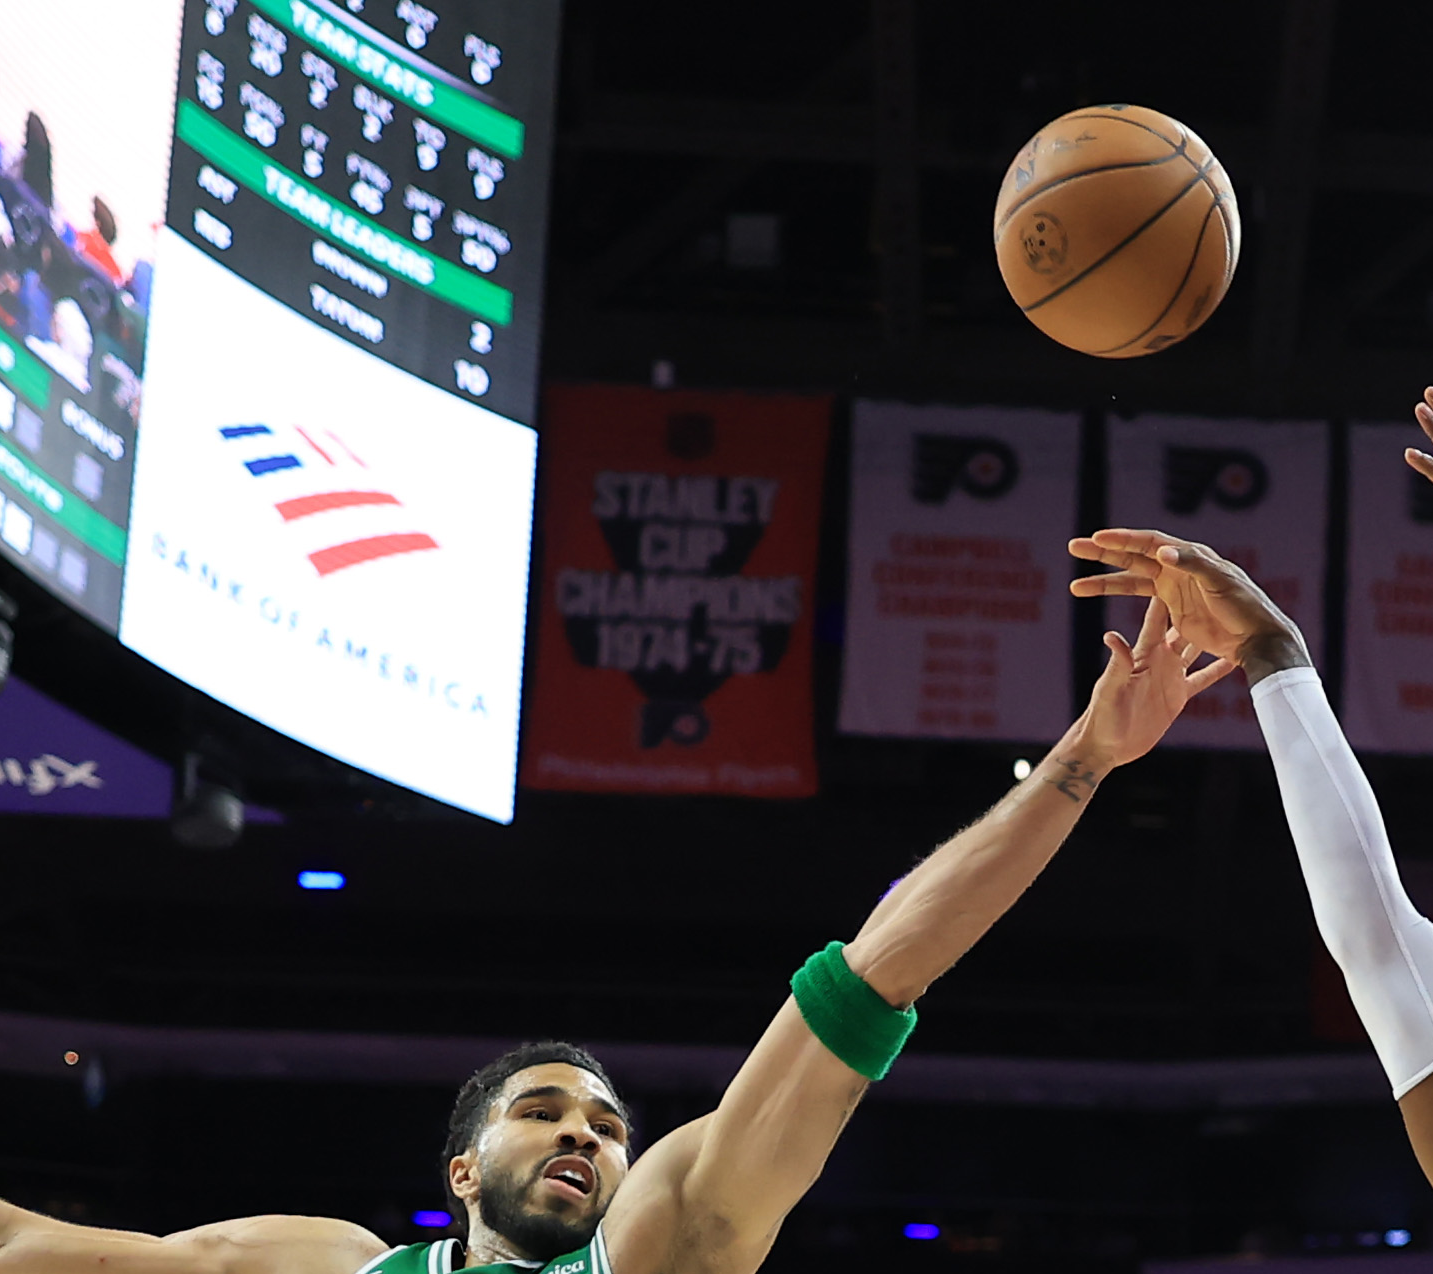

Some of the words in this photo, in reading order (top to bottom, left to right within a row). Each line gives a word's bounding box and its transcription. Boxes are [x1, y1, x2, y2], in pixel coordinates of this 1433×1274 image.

[592, 470, 780, 525] STANLEY
[639, 523, 728, 572] CUP
[555, 568, 804, 625] CHAMPIONS
[596, 622, 764, 675] 1974-75
